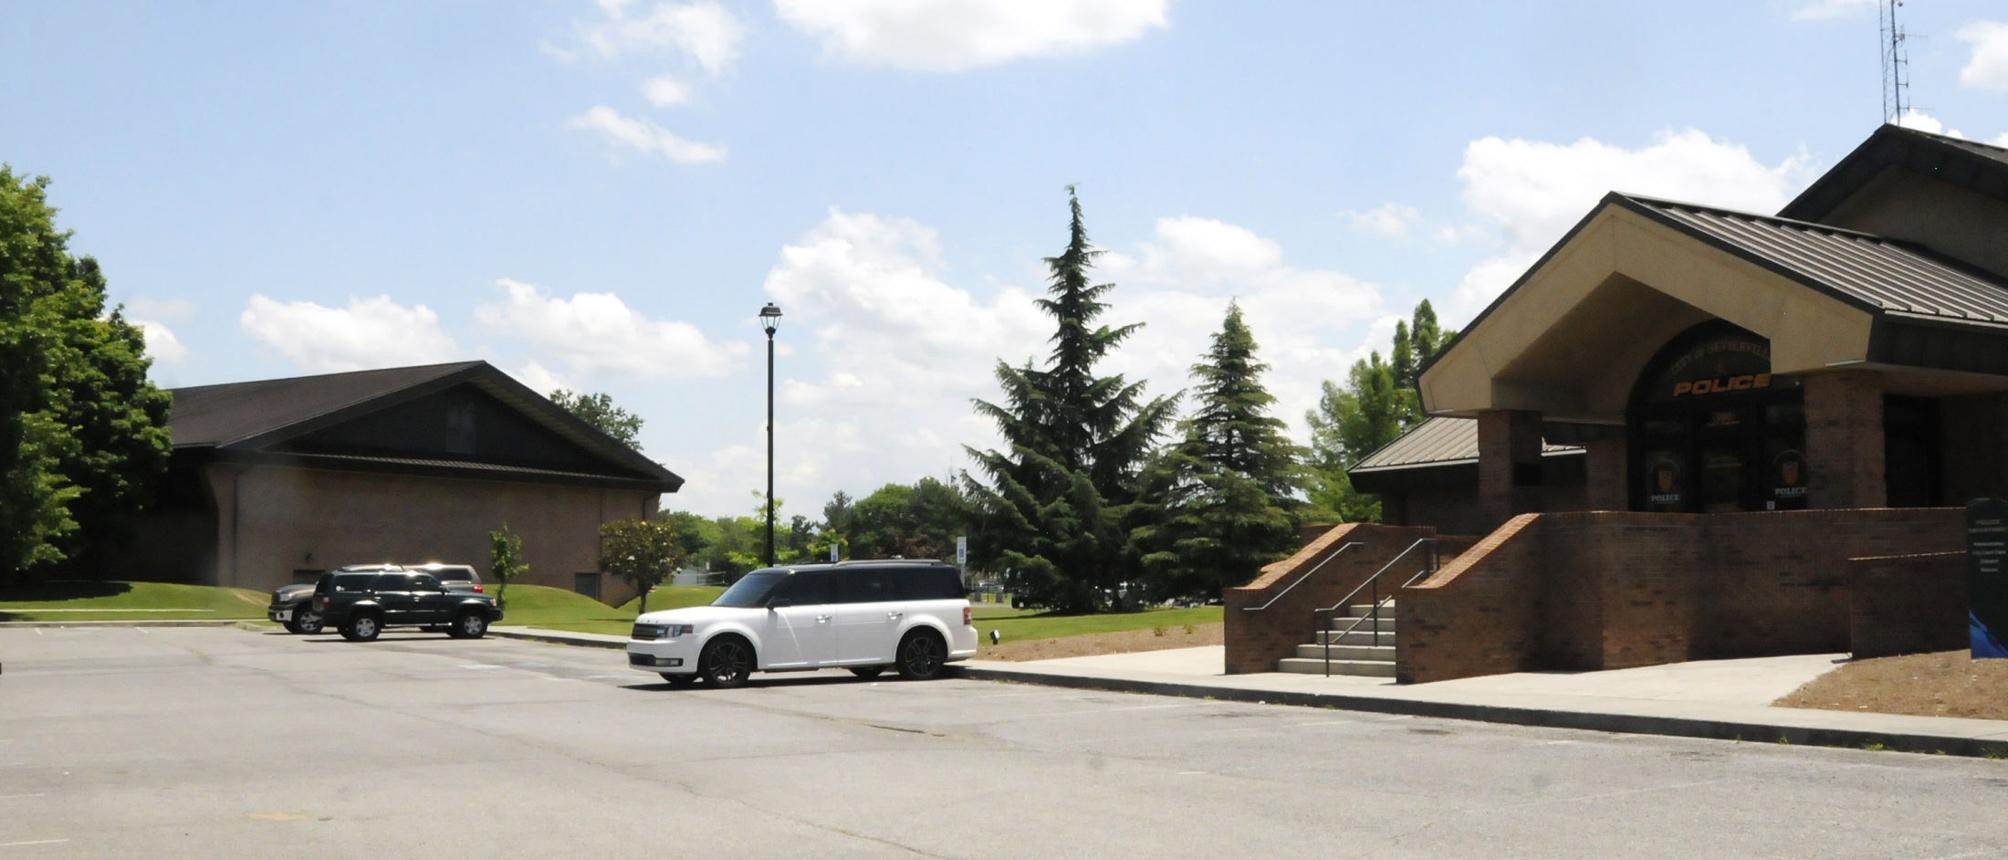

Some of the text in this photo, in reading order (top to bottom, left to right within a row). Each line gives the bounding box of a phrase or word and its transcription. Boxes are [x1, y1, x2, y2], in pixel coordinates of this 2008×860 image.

[1706, 340, 1770, 361] SEVIERVILL
[1673, 372, 1772, 397] POLICE
[1651, 494, 1680, 503] POLICE
[1774, 487, 1807, 496] POLICE
